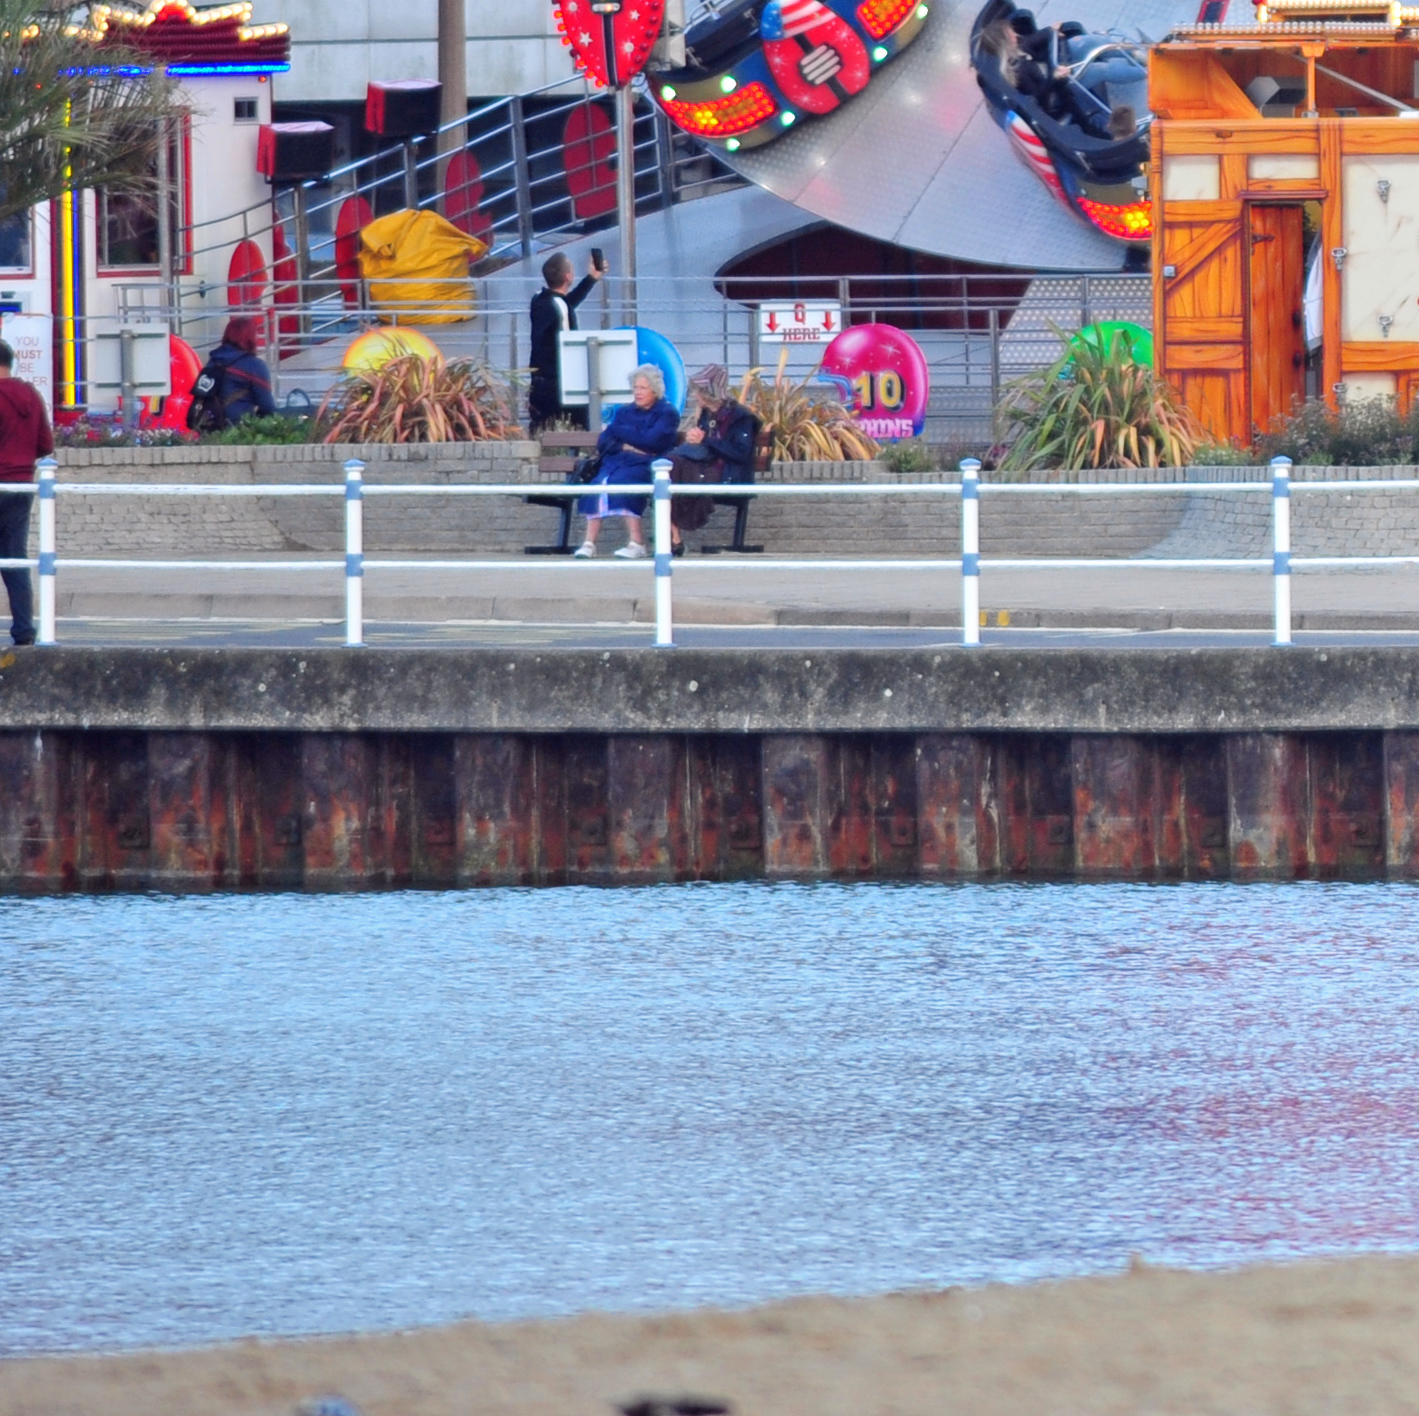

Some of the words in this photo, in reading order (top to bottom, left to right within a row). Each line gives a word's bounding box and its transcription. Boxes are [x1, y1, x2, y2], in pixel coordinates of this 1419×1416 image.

[794, 302, 806, 325] Q
[17, 337, 38, 345] YOU
[783, 328, 820, 341] HERE
[855, 370, 905, 412] 10
